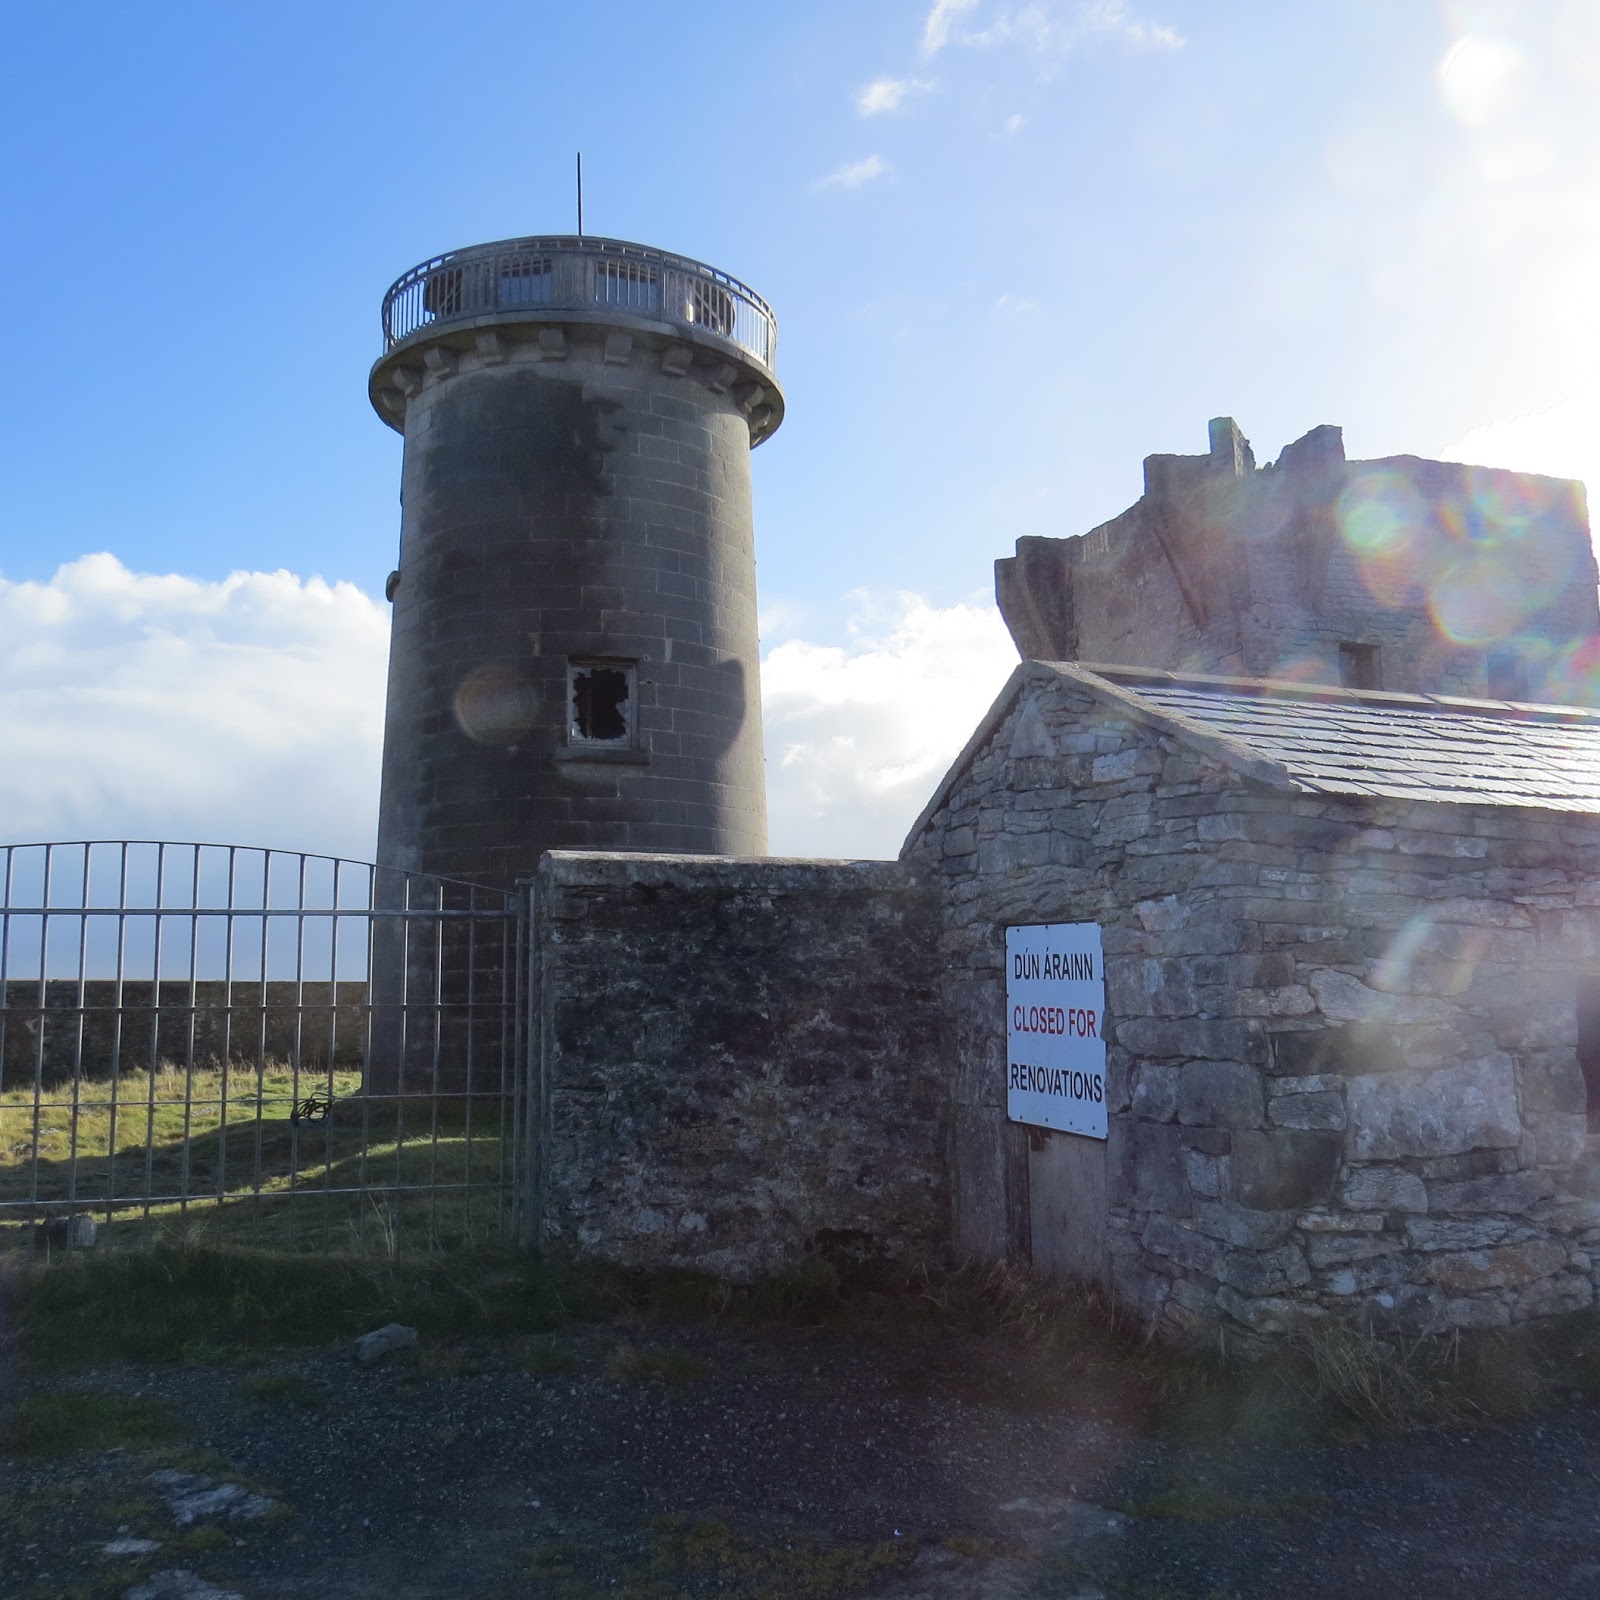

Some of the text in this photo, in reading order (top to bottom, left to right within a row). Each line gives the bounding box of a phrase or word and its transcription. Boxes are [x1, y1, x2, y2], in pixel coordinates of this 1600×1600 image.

[1014, 947, 1093, 981] DÚN ÁRAINN
[1013, 1005, 1097, 1038] CLOSED FOR
[1011, 1063, 1103, 1103] RENOVATIONS
